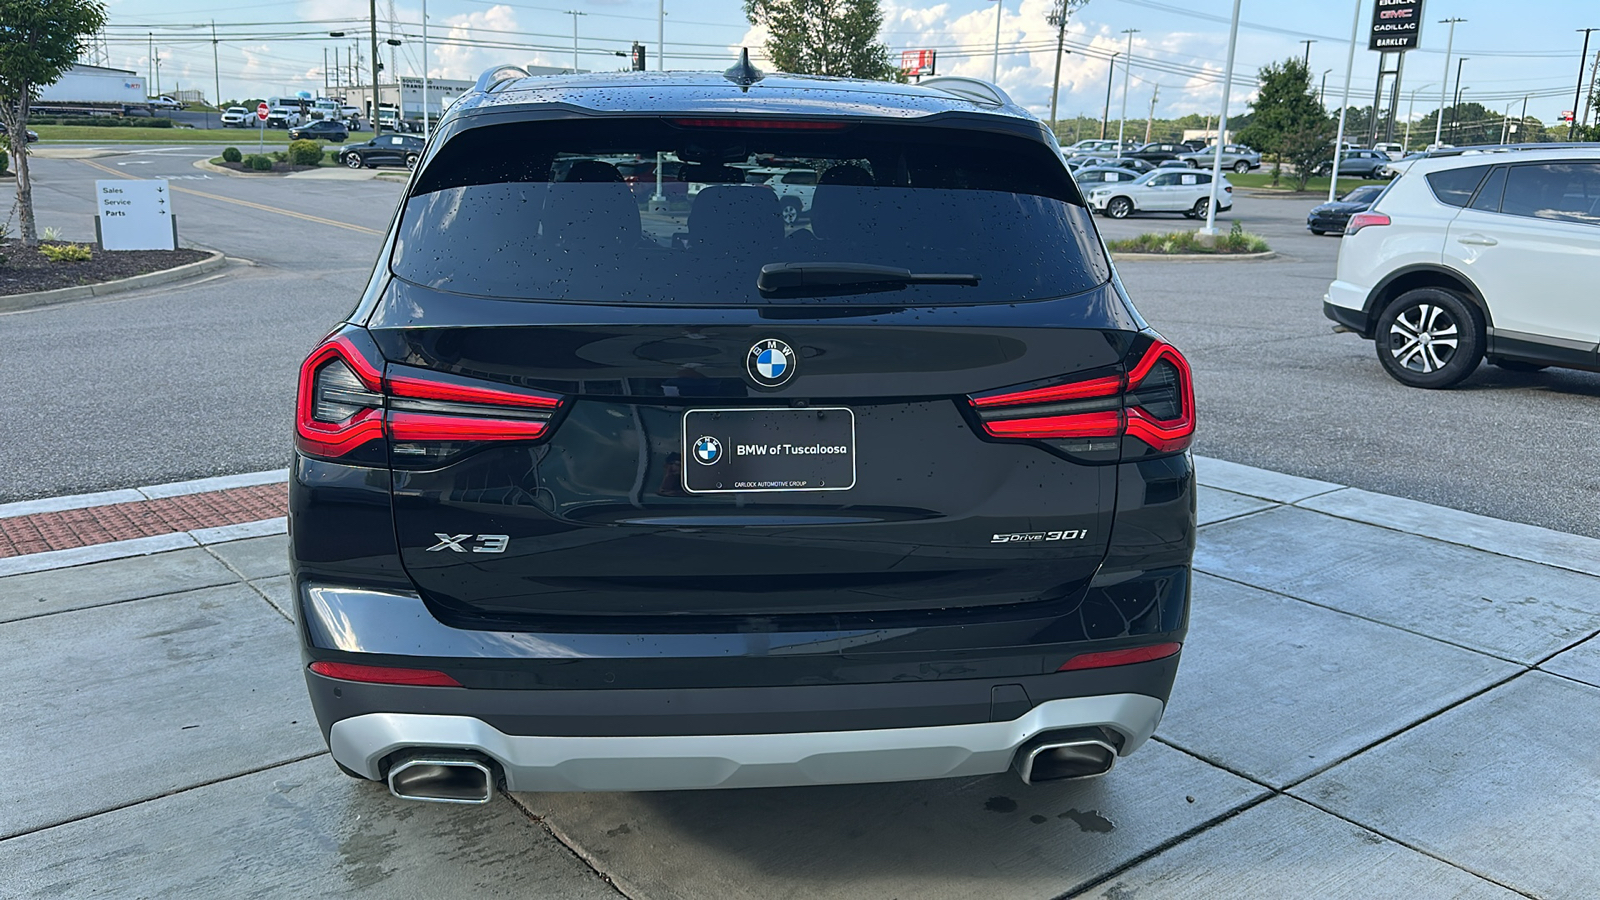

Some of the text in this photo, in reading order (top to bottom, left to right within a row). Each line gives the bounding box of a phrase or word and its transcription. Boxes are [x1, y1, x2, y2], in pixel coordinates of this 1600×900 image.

[1380, 9, 1413, 19] GMC
[1373, 23, 1416, 31] CADILLAC
[1376, 38, 1408, 47] BARKLEY
[736, 444, 847, 455] BMW of Tuscaloosa
[425, 532, 510, 553] X3
